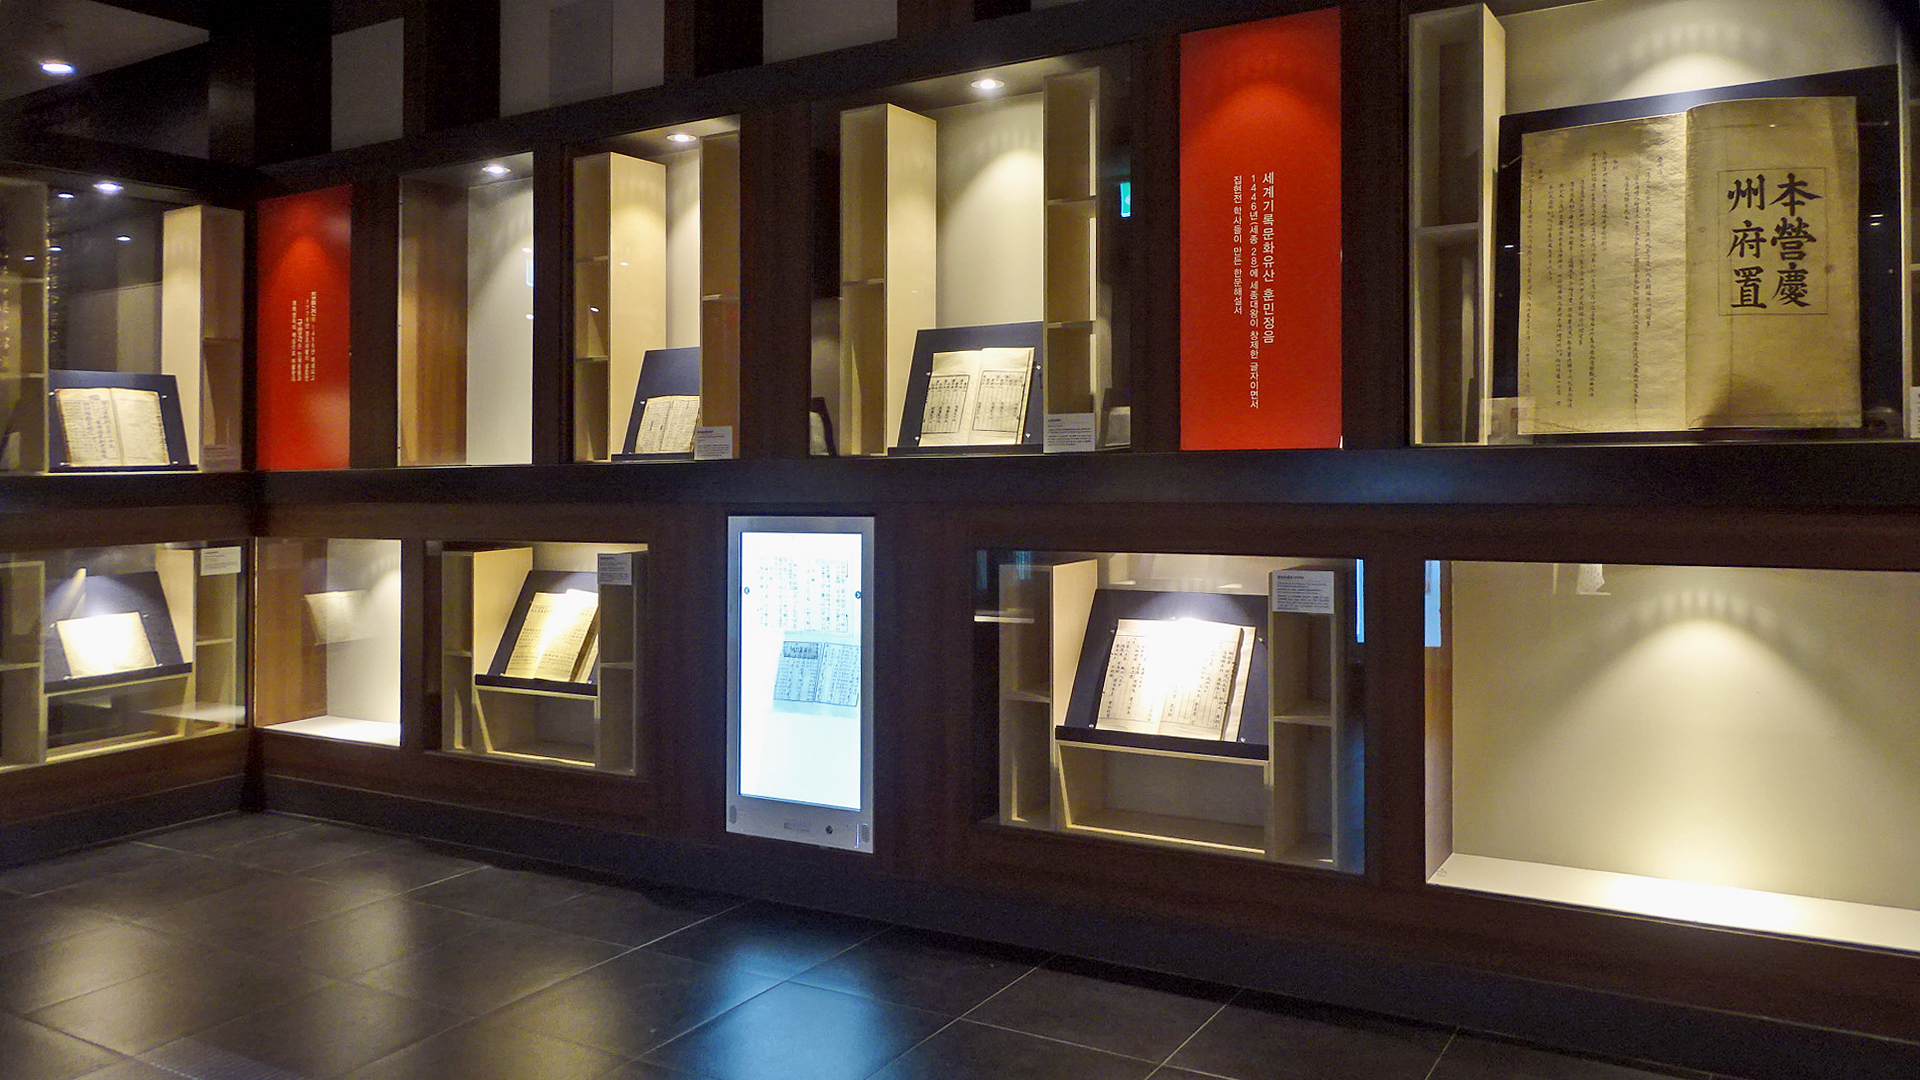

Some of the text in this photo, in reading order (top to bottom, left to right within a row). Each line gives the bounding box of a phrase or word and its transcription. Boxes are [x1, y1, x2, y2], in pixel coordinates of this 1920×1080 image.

[1233, 175, 1243, 204] 집현전
[1233, 206, 1243, 244] 학사들이
[1726, 174, 1767, 309] 州府置
[1769, 172, 1823, 308] 本營慶
[1233, 268, 1243, 315] 한문해설서
[1249, 174, 1260, 410] 1446년(세종 28)에 세종대왕이 창제한 글자이면서
[1262, 171, 1275, 344] 세계기록문화유산 훈민정음
